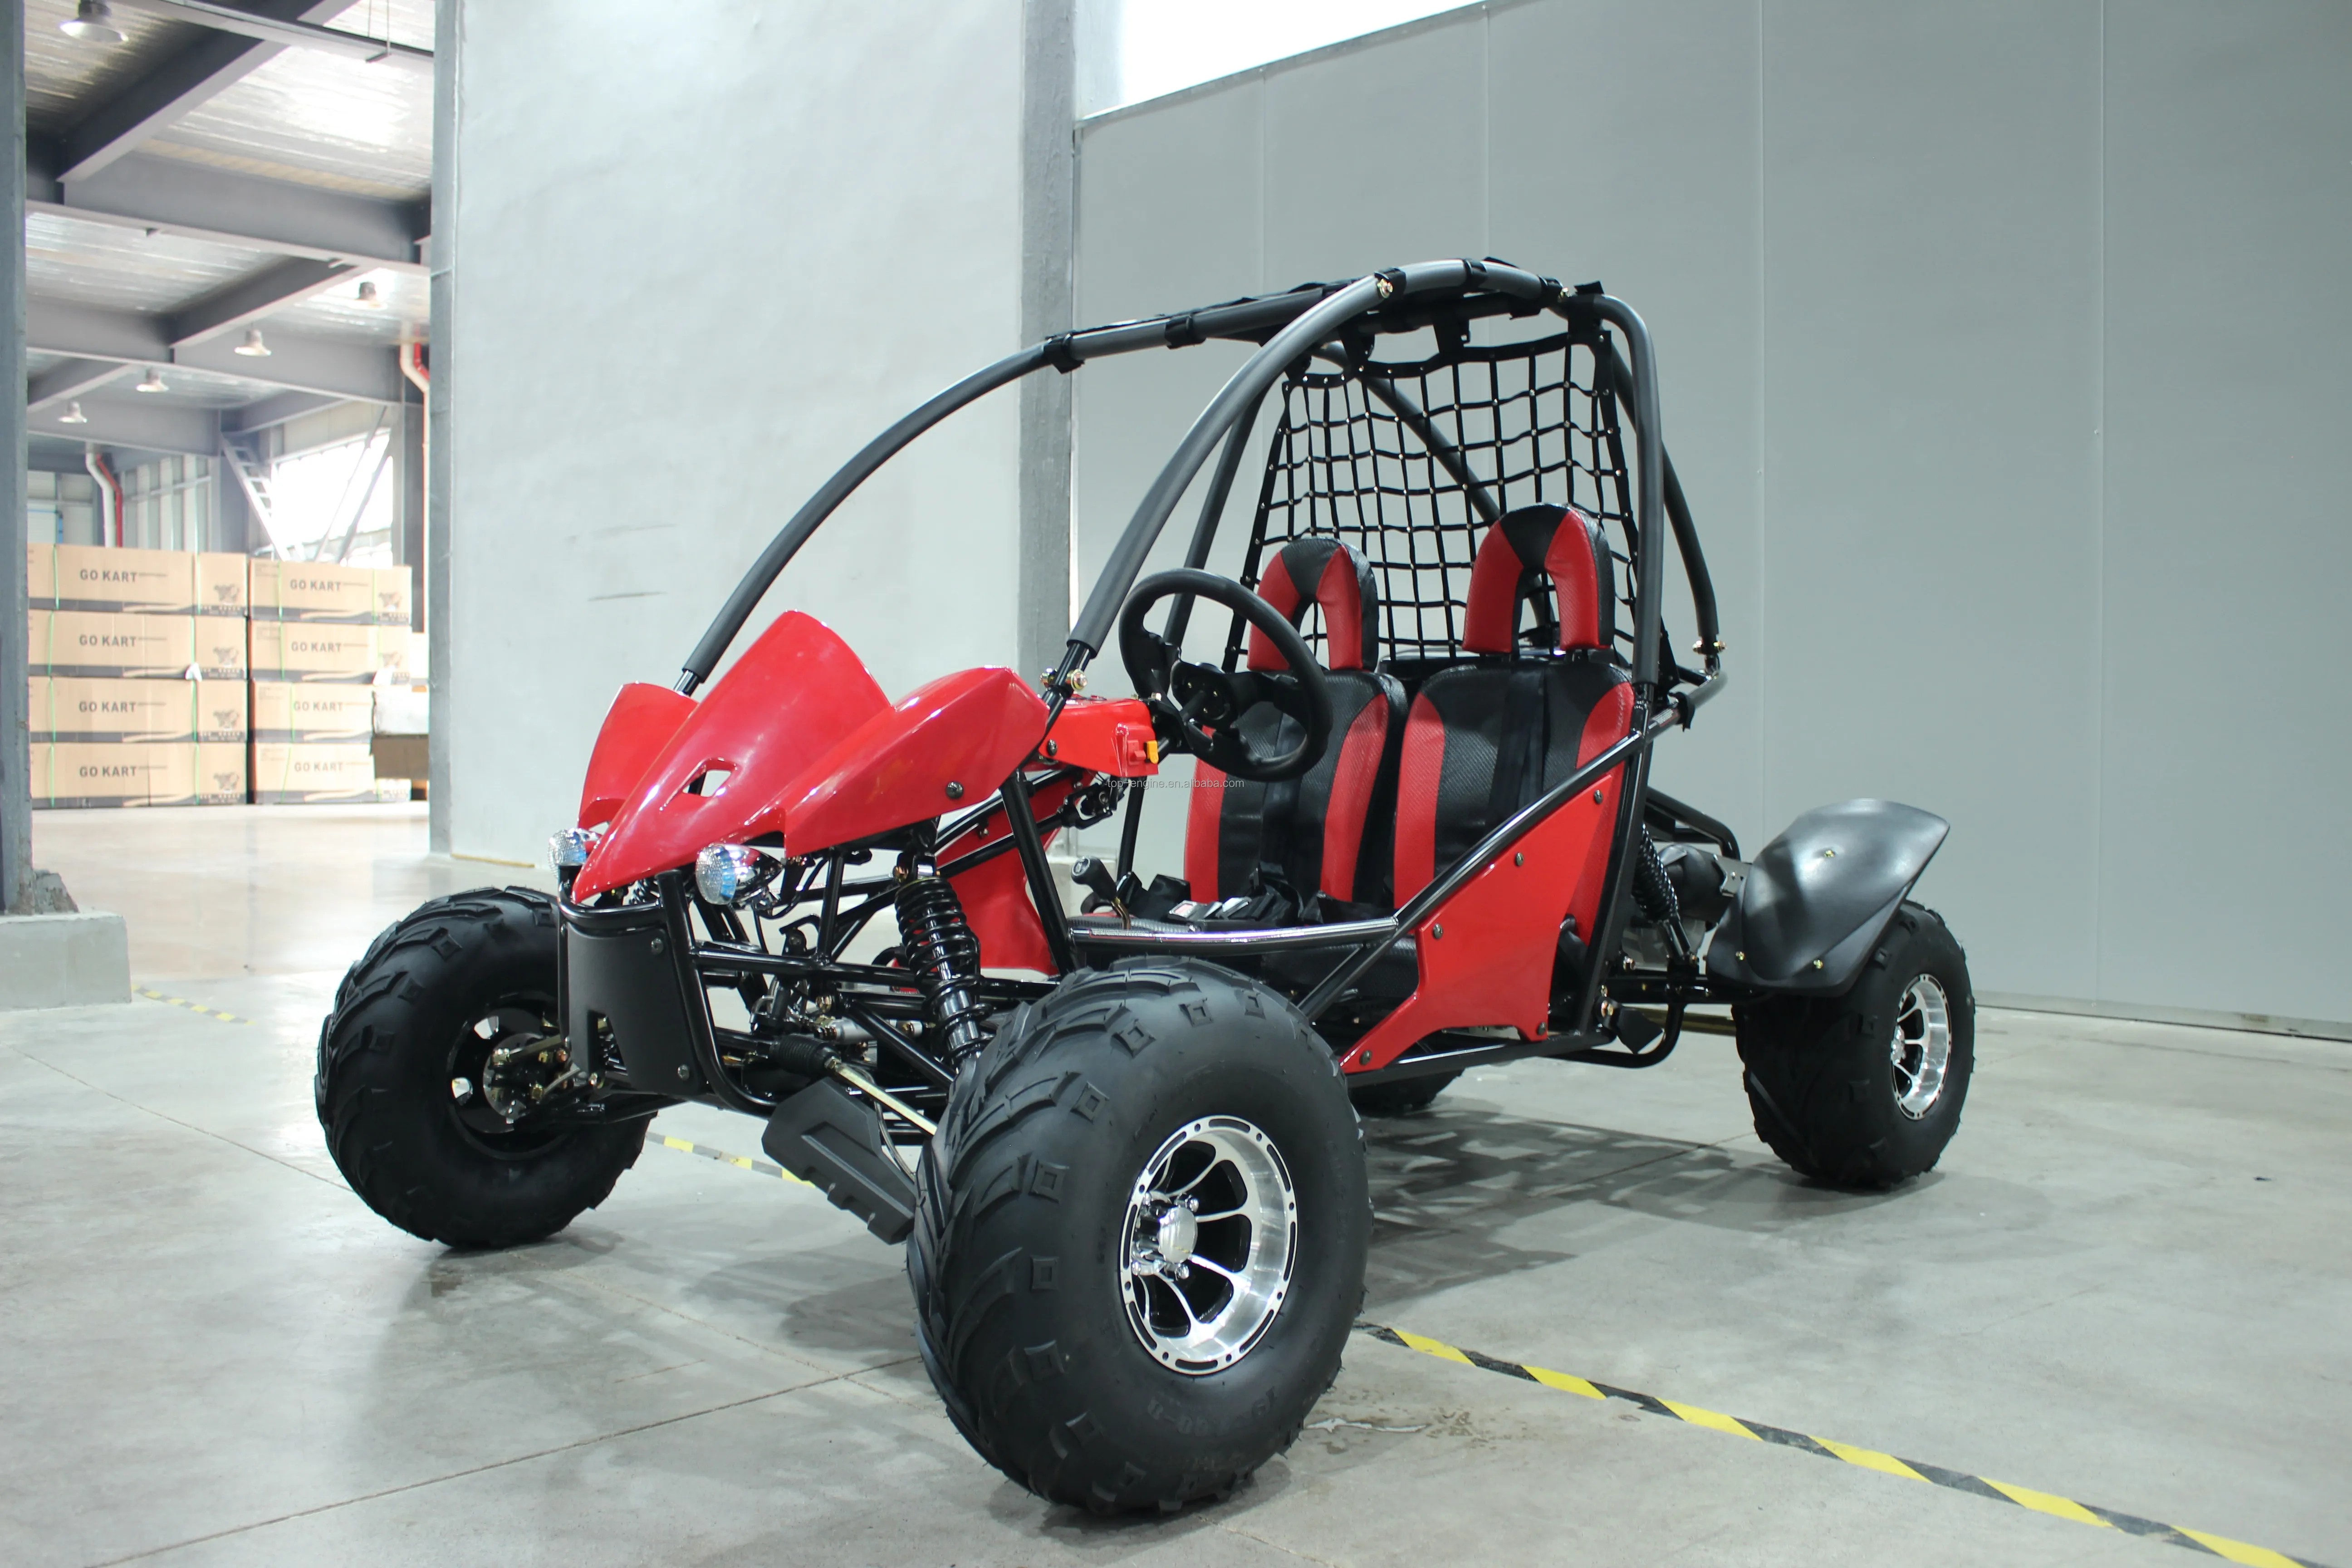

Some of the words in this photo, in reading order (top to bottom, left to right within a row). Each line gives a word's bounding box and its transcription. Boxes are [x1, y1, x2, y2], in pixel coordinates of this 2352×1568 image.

[80, 569, 98, 581] GO
[103, 570, 137, 582] KART
[290, 579, 306, 590] GO
[310, 580, 341, 591] KART
[79, 634, 97, 646] GO
[102, 635, 137, 647] KART
[291, 642, 307, 652] GO
[311, 642, 342, 652] KART
[78, 701, 97, 712] GO
[102, 701, 136, 712] KART
[293, 701, 309, 711] GO
[313, 701, 343, 711] KART
[79, 765, 98, 777] GO
[102, 766, 137, 777] KART
[294, 762, 310, 772] GO
[314, 762, 343, 772] KART
